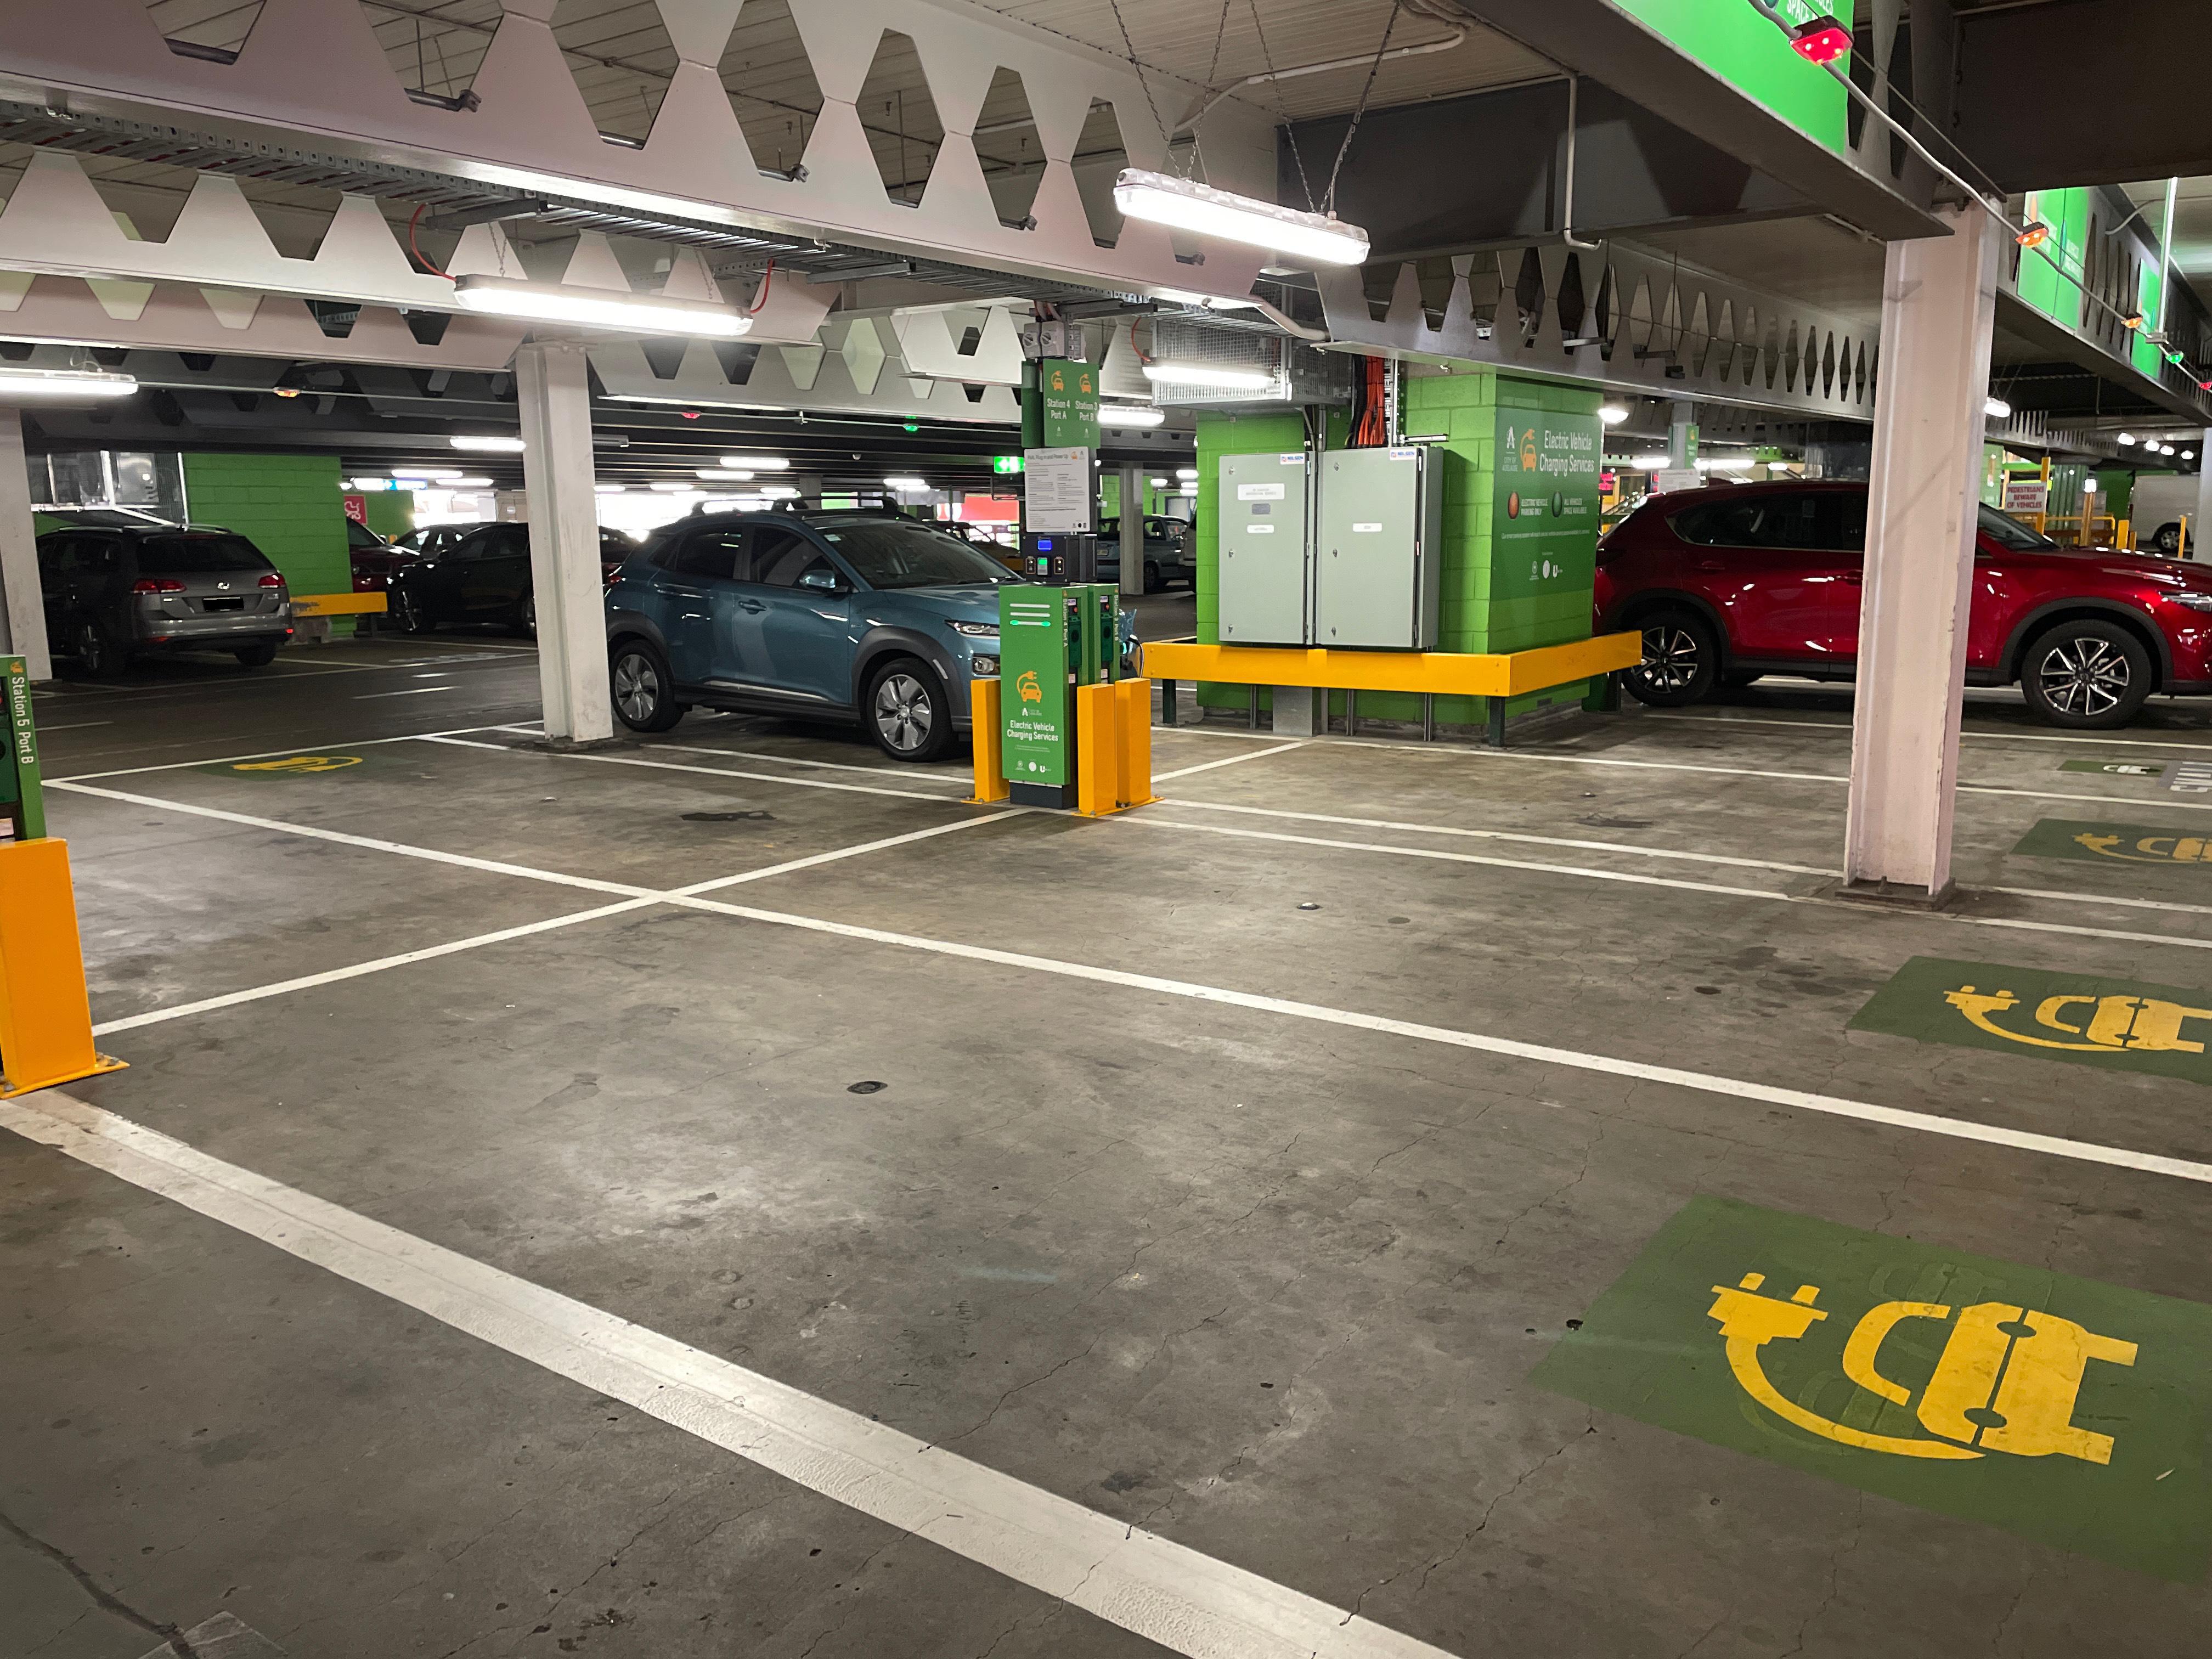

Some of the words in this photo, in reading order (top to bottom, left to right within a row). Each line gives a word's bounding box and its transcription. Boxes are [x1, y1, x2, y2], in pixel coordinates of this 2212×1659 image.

[1047, 398, 1065, 408] Station
[1066, 400, 1070, 408] 4
[1075, 400, 1093, 410] Station
[1051, 410, 1062, 419] Port
[1062, 411, 1067, 420] A
[1079, 412, 1090, 421] Port
[1544, 430, 1569, 450] Electric
[1570, 432, 1592, 450] Vehicle
[1539, 453, 1568, 477] Charging
[1569, 454, 1594, 472] Services
[12, 676, 27, 717] Station
[1010, 720, 1032, 730] Electric
[1033, 722, 1055, 732] Vehicle
[1007, 729, 1032, 741] Charging
[1033, 731, 1058, 742] Services
[18, 731, 32, 754] Port
[21, 756, 34, 764] B
